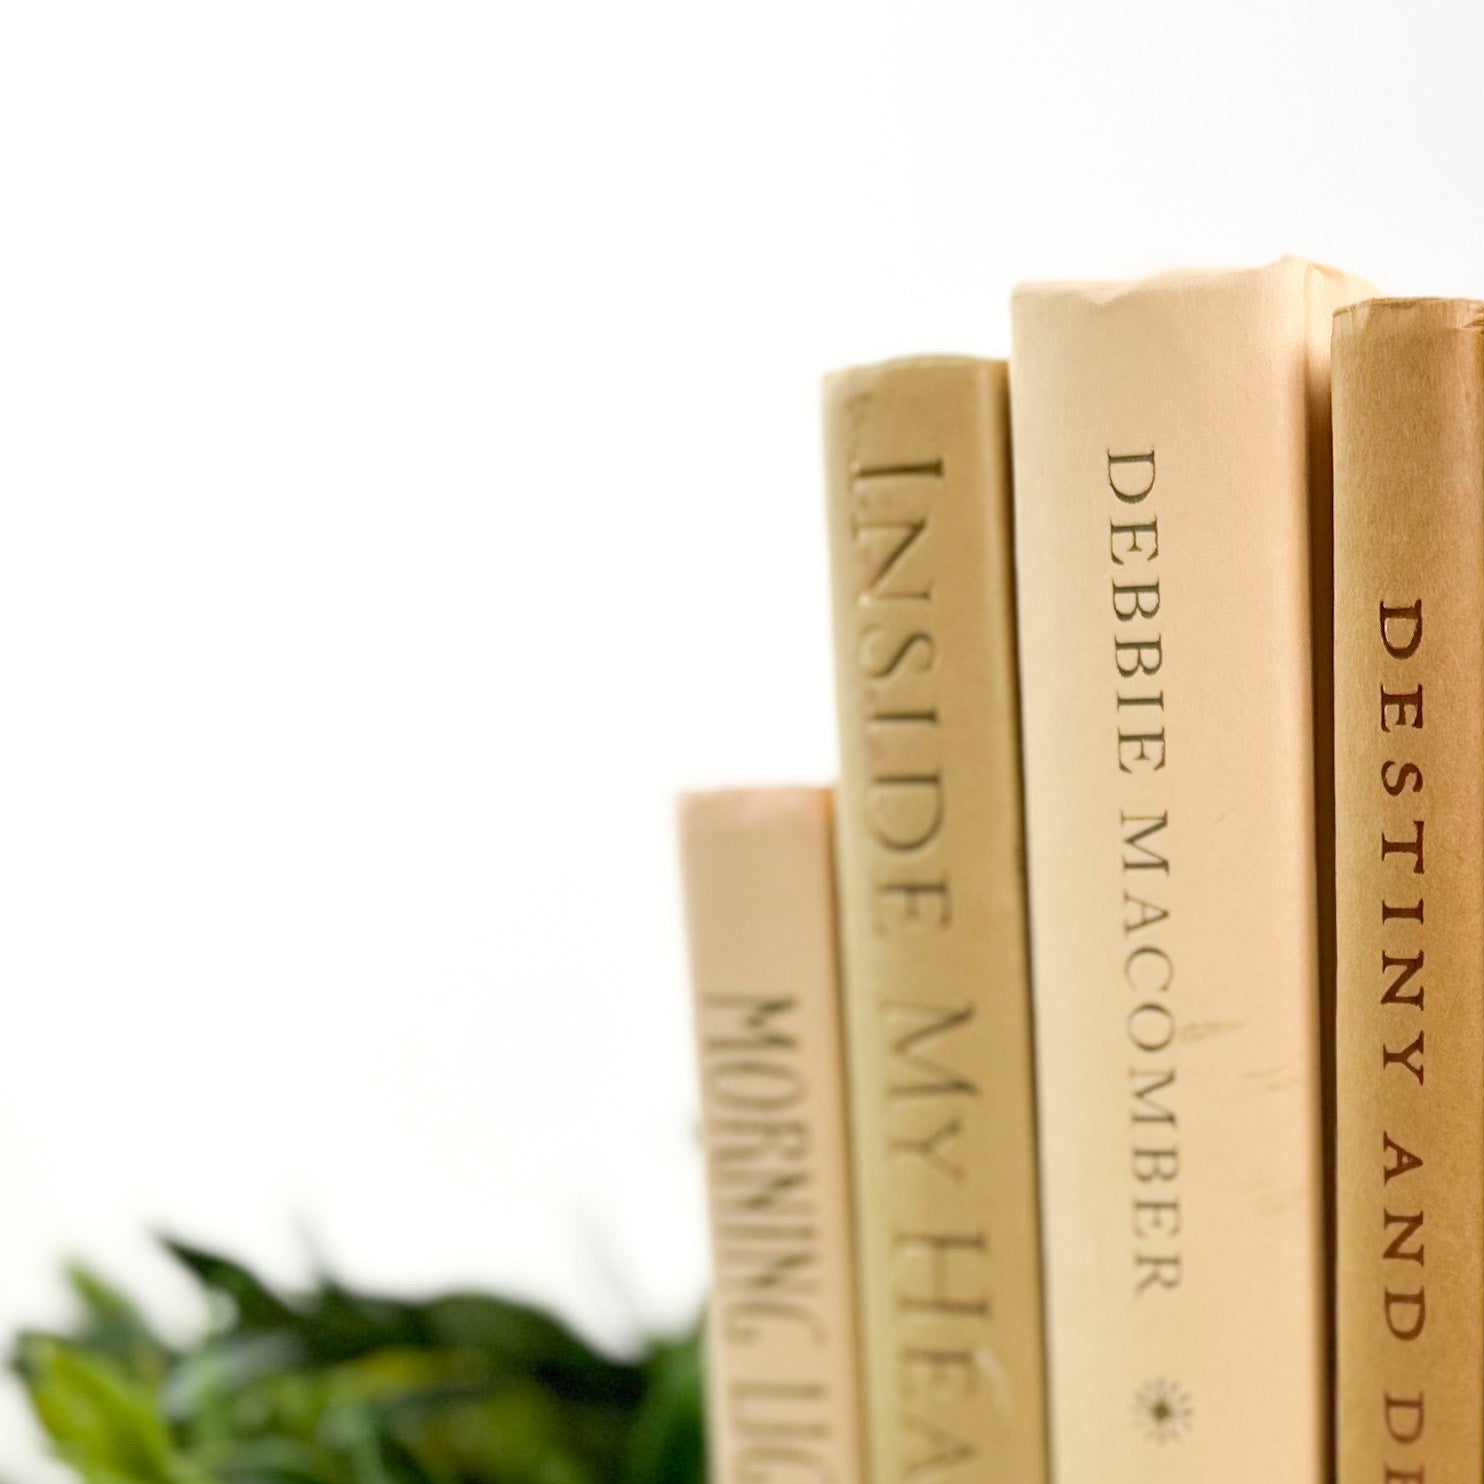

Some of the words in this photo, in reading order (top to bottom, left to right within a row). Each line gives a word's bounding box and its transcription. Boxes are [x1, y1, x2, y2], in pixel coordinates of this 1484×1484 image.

[848, 455, 953, 930] INSIDE
[1106, 447, 1166, 775] DEBBIE
[1379, 599, 1425, 1085] DESTINY
[700, 992, 823, 1352] MORNING
[882, 1000, 981, 1187] MY
[1120, 809, 1182, 1298] MACOMBER
[1382, 1130, 1426, 1343] AND
